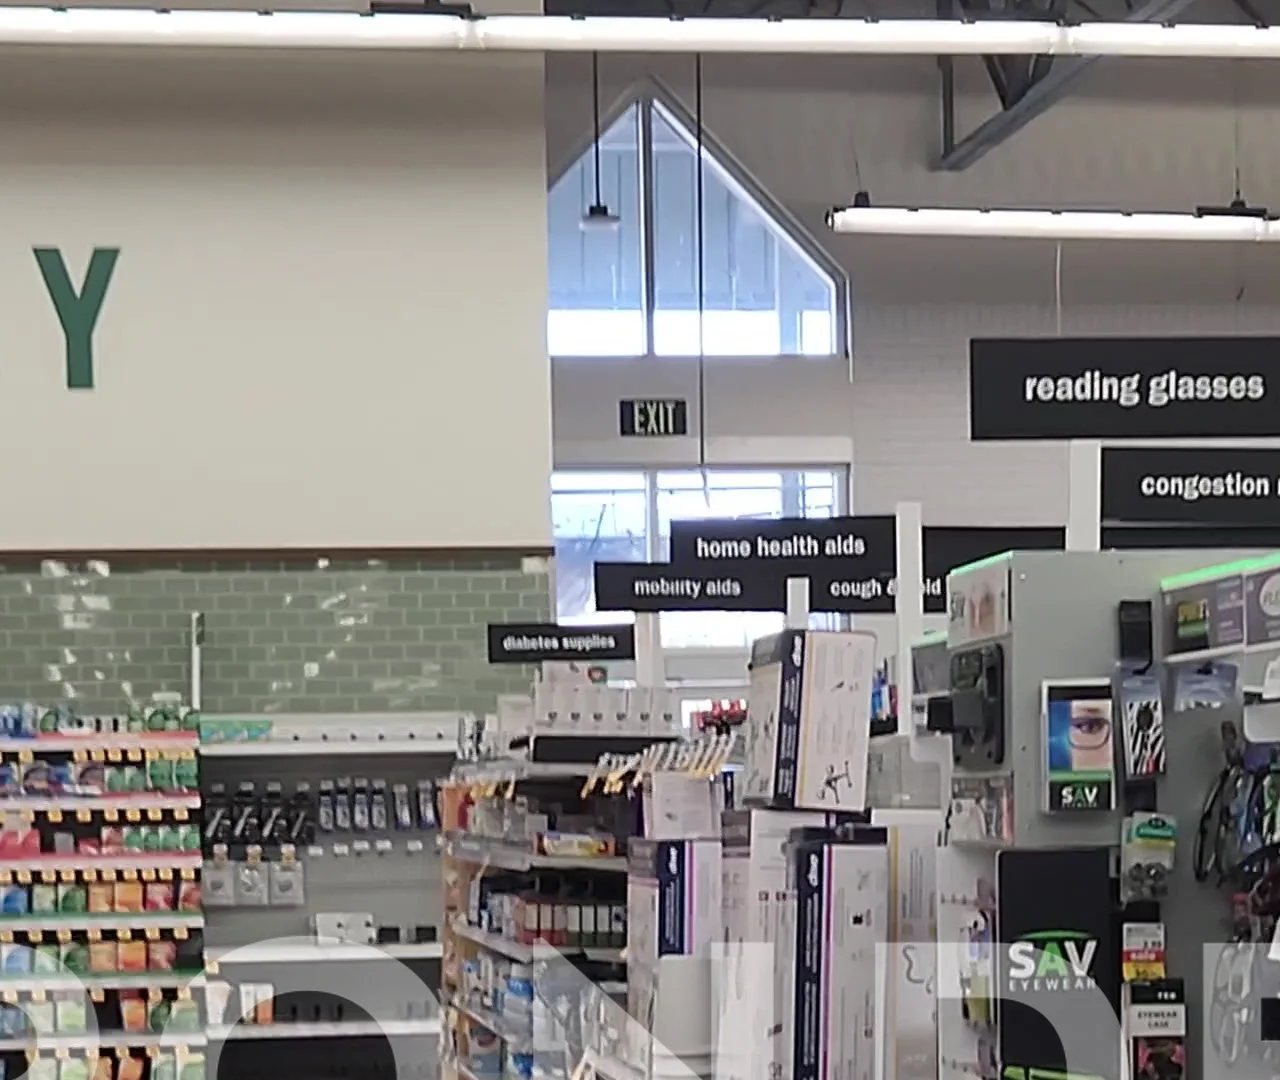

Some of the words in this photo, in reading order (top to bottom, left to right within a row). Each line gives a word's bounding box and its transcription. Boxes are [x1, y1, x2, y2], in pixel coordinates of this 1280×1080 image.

[1025, 370, 1140, 406] reading
[1147, 369, 1265, 406] glasses
[634, 402, 676, 434] EXIT
[1141, 472, 1270, 500] congestion
[697, 536, 751, 558] home
[757, 535, 819, 557] health
[825, 534, 866, 556] aids
[634, 578, 701, 599] mobility
[706, 578, 741, 597] aids
[830, 578, 881, 600] cough
[503, 634, 560, 651] diabetes
[562, 634, 615, 653] supplies
[1008, 939, 1098, 979] SAV
[1008, 978, 1097, 993] EYEWEAR
